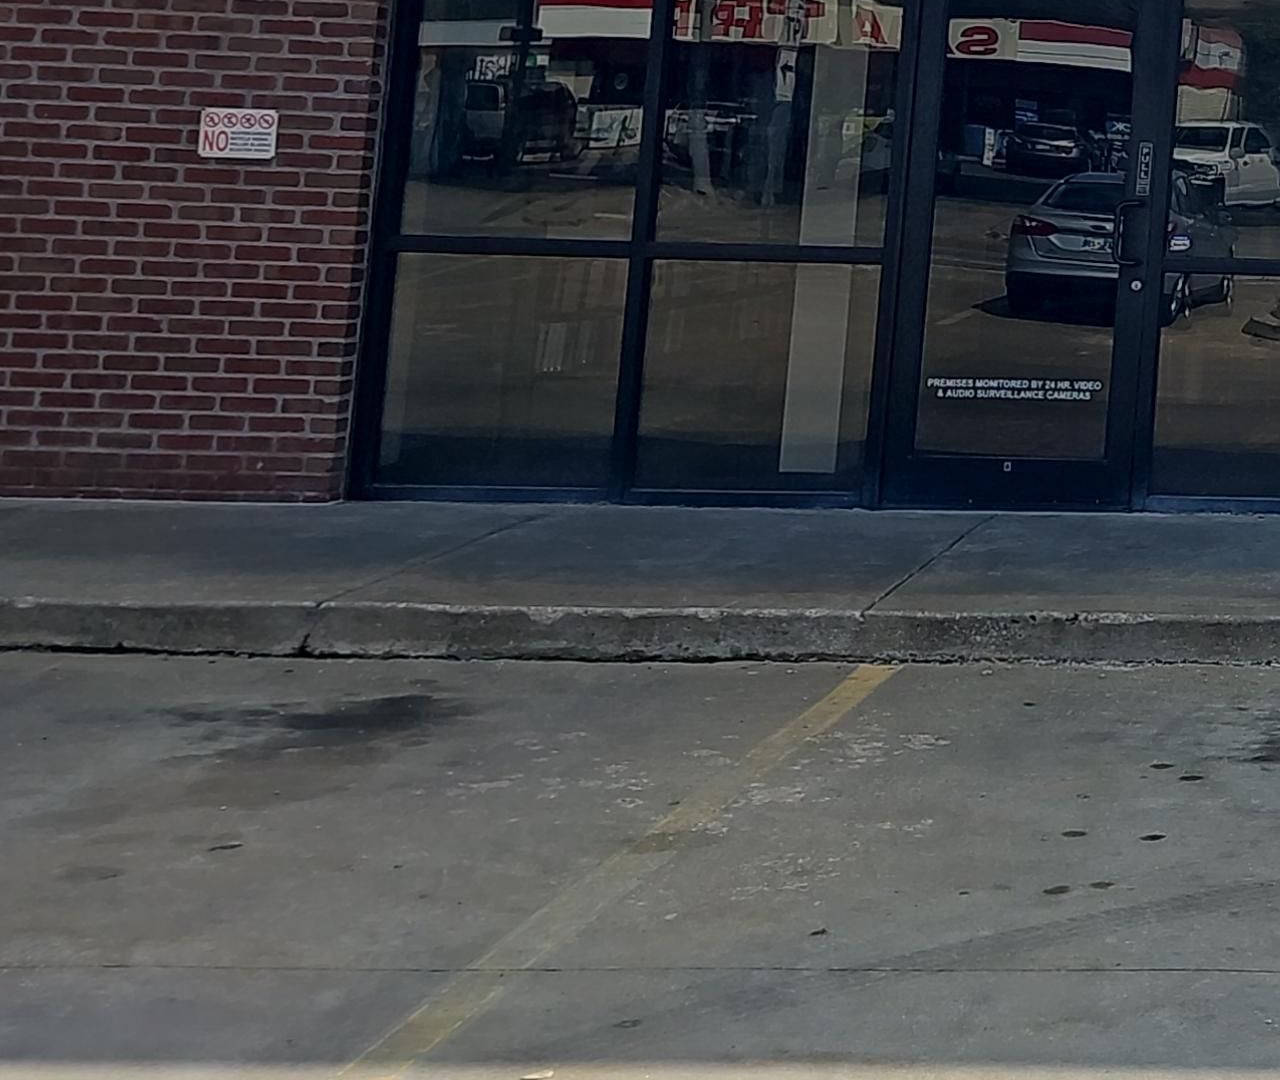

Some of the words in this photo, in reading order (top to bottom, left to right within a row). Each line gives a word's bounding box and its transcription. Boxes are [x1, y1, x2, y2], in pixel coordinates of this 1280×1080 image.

[202, 130, 229, 152] NO
[1140, 147, 1150, 179] PULL
[927, 378, 973, 387] PREMISES
[975, 379, 1029, 388] MONITORED
[1031, 380, 1043, 388] BY
[1045, 381, 1056, 389] 24
[1074, 381, 1102, 390] VIDEO
[945, 389, 975, 398] AUDIO
[976, 389, 1045, 399] SURVEILLANCE
[1046, 390, 1091, 400] CAMERAS
